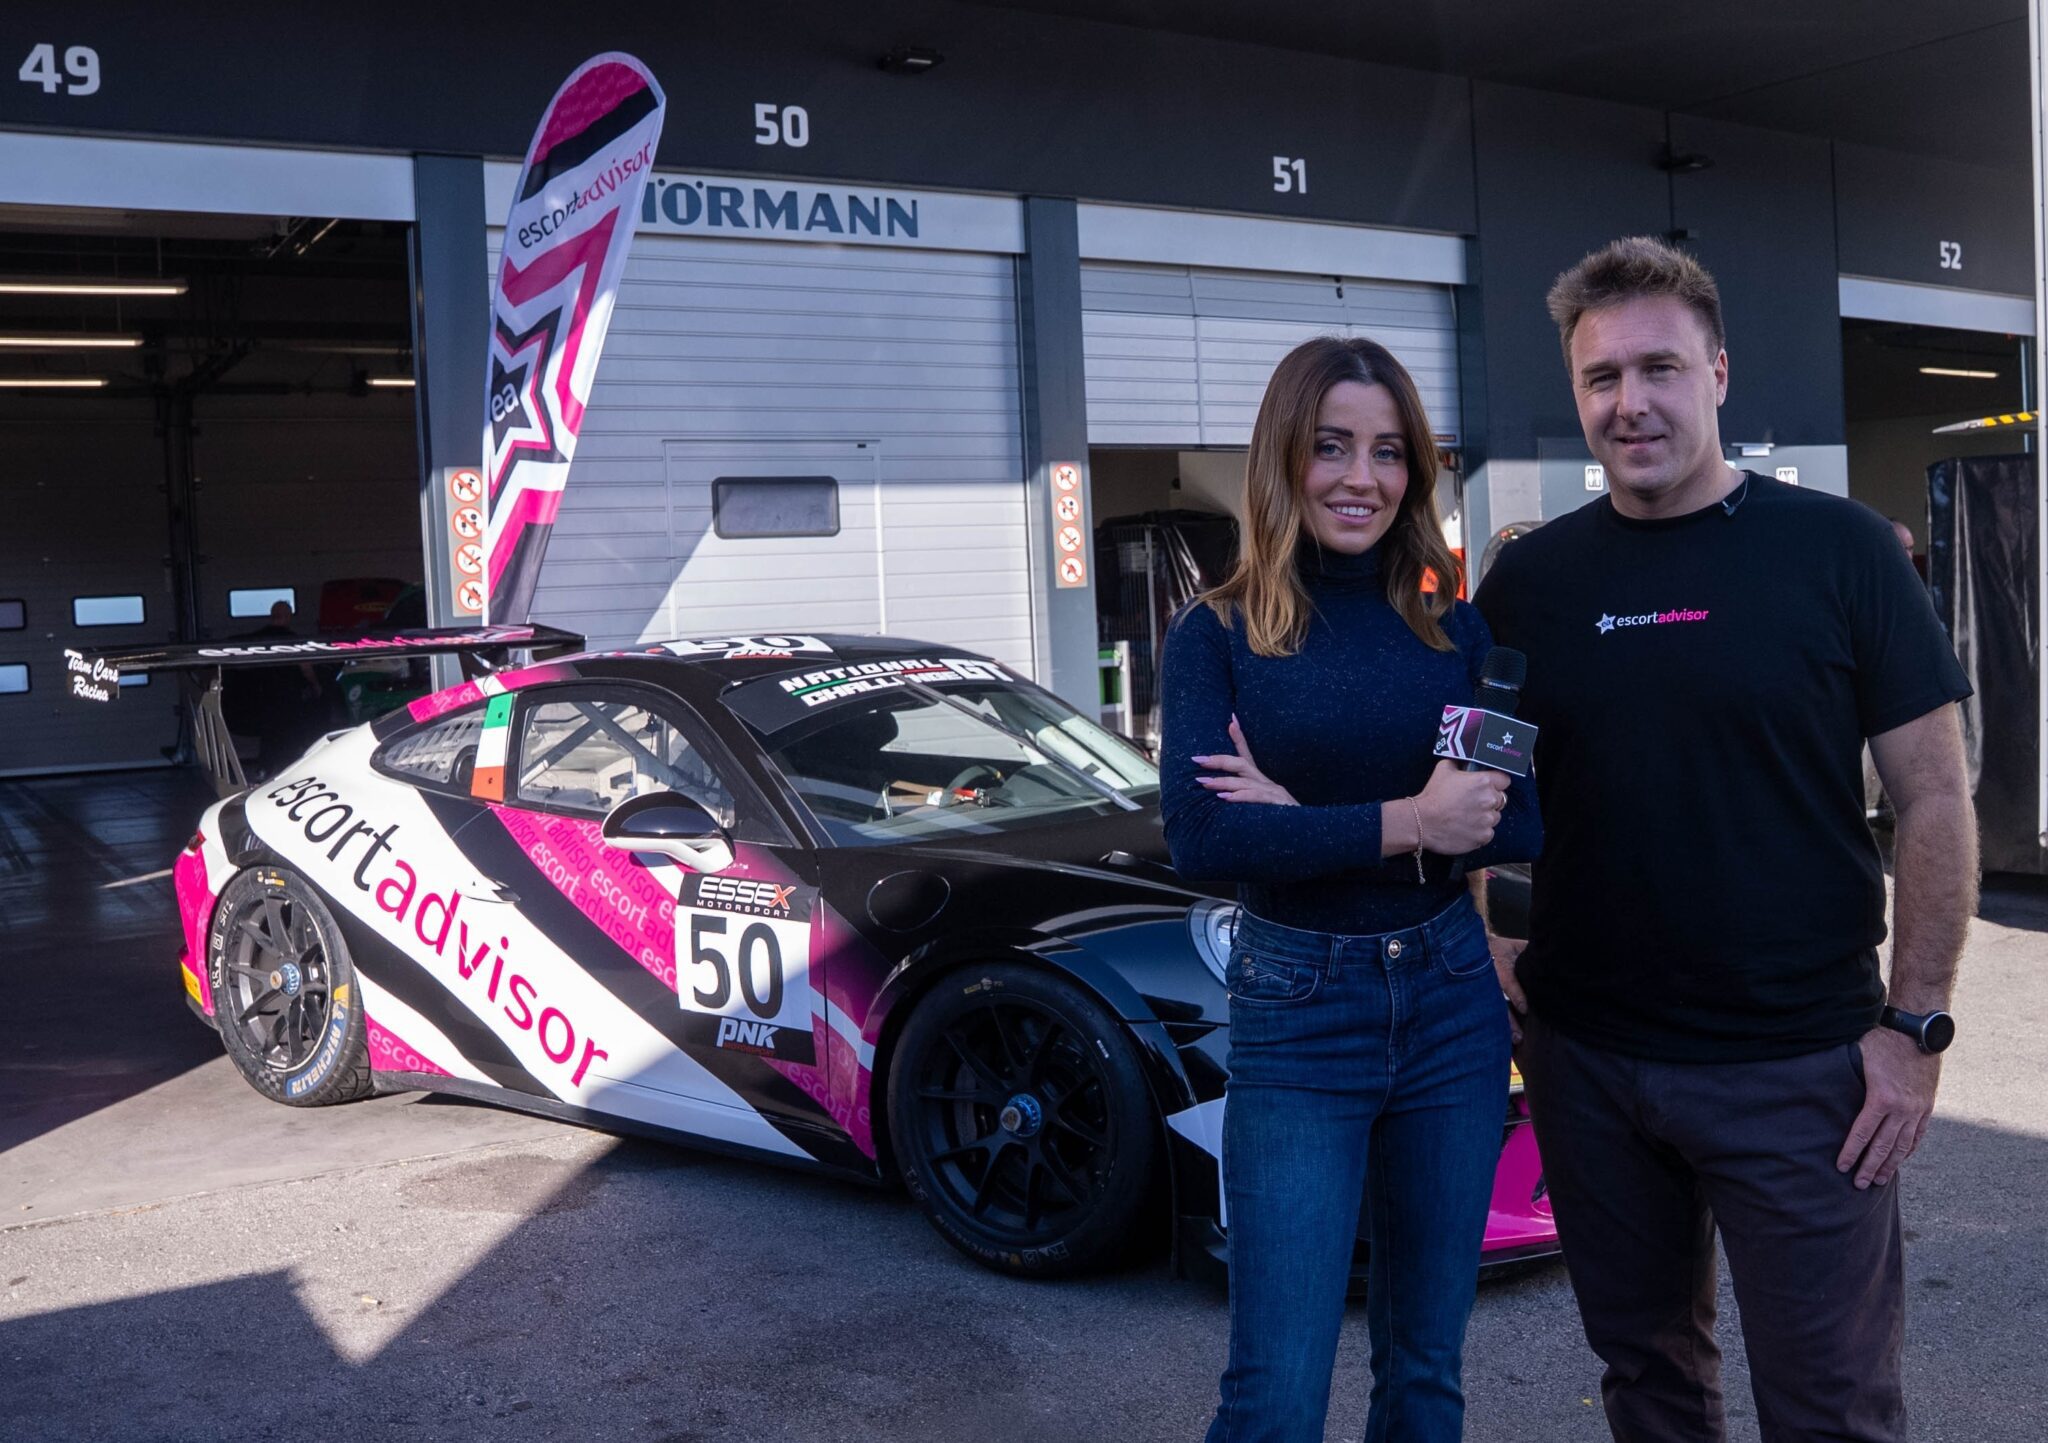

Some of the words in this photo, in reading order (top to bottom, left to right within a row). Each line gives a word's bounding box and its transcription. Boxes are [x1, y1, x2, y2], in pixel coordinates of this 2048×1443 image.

[19, 43, 100, 95] 49
[754, 103, 809, 147] 50
[1273, 156, 1306, 194] 51
[1940, 240, 1962, 270] 52
[491, 383, 519, 422] ea
[1617, 608, 1709, 627] escortadvisor
[64, 648, 92, 675] Team
[93, 657, 119, 683] Cars
[779, 659, 943, 693] NATIONAL
[939, 658, 1014, 682] GT
[697, 899, 789, 918] MOTORSPORT
[698, 876, 796, 910] ESSEX
[267, 776, 608, 1088] escortadvisor
[691, 913, 784, 1020] 50
[716, 1017, 779, 1049] PNK
[291, 1023, 342, 1095] MICHELIN
